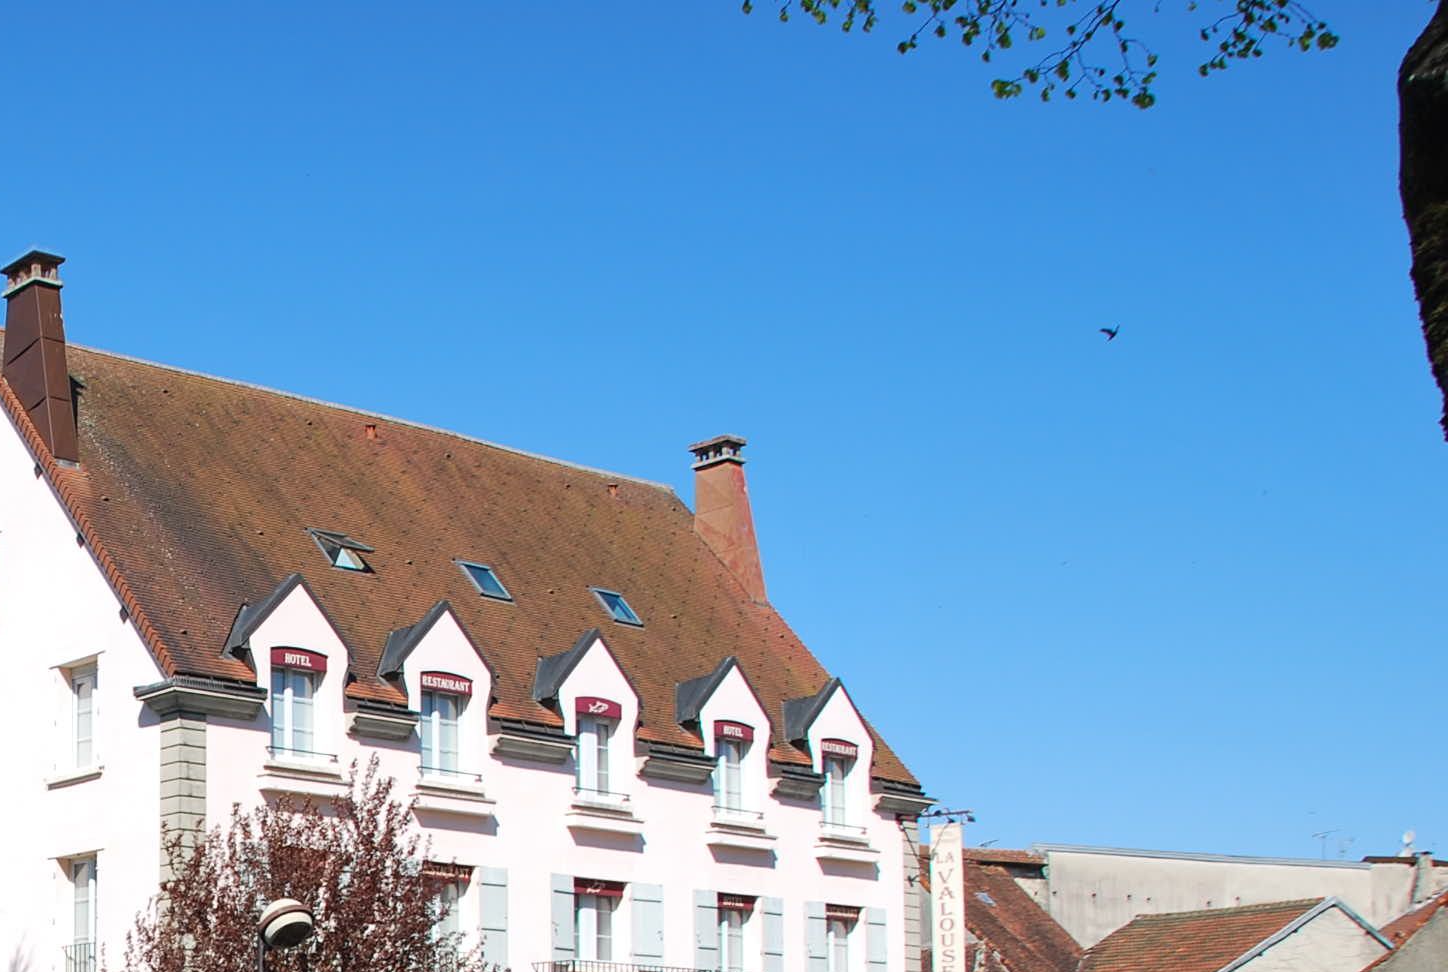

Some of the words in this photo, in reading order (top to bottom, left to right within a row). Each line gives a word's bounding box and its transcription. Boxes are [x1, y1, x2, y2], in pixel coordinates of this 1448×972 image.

[284, 652, 312, 667] HOTEL
[422, 675, 470, 692] RESTAURANT
[723, 725, 744, 737] HOTEL
[936, 851, 954, 863] LA
